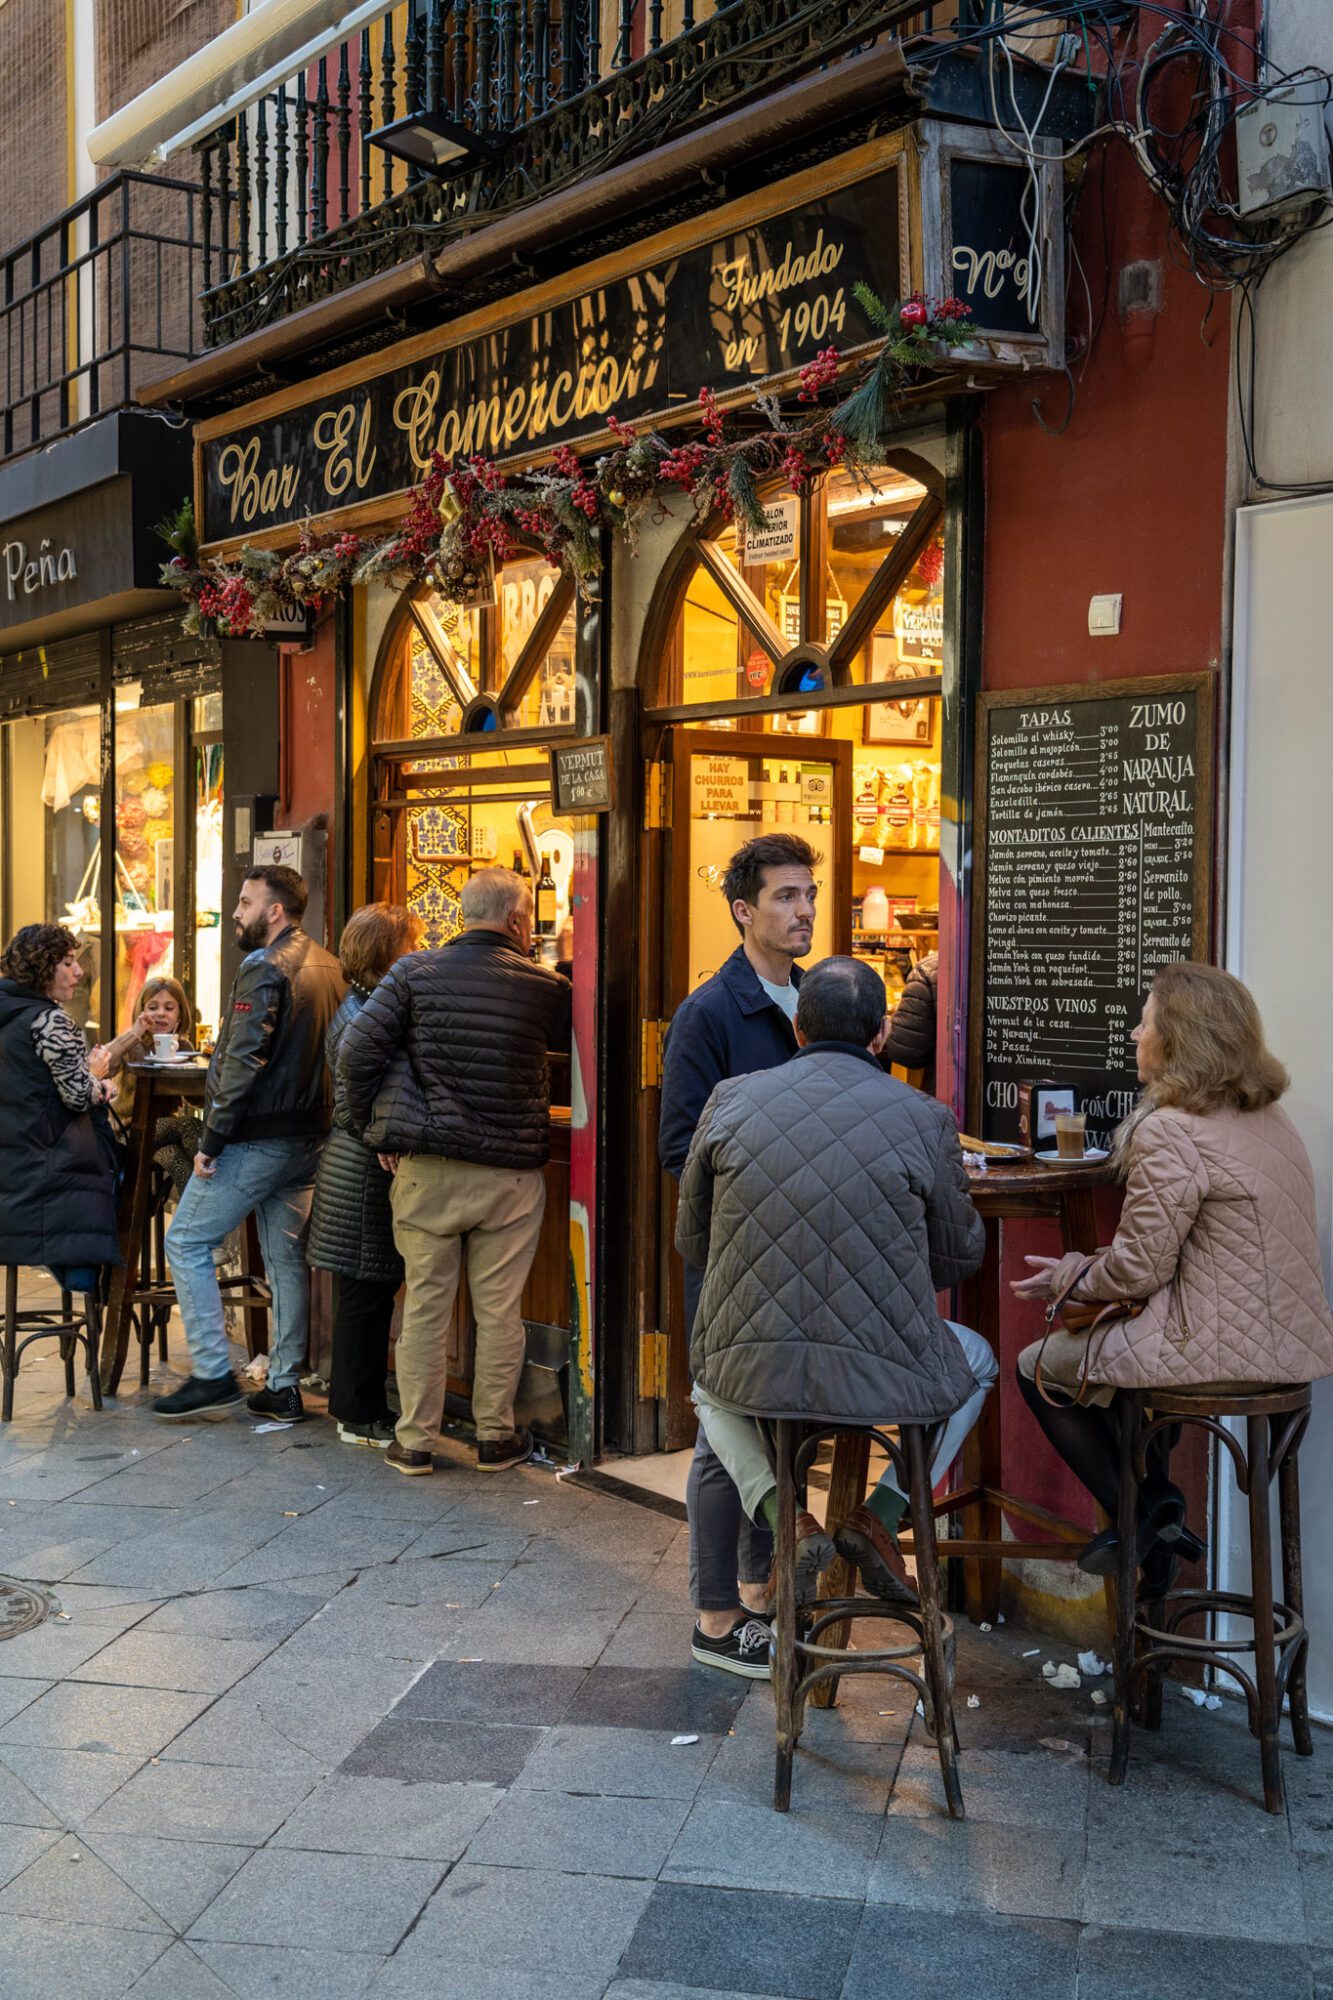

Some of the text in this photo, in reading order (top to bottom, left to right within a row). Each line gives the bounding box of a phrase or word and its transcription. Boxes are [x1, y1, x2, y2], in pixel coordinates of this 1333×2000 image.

[722, 228, 844, 311] Fundado
[725, 287, 846, 369] en 1904
[218, 356, 632, 524] Bar El Comercio
[763, 507, 784, 519] ALON
[747, 533, 794, 551] CLIMATIZADO
[2, 538, 77, 601] Peña
[1020, 709, 1071, 728] TAPAS
[1128, 701, 1186, 728] ZUMO
[990, 732, 1029, 746] Solomillo
[1031, 732, 1040, 742] al
[1144, 731, 1171, 751] DE
[990, 745, 1028, 758] Solomillo
[1030, 745, 1038, 755] al
[560, 750, 604, 771] VERMUT
[991, 759, 1029, 773] Croquetas
[709, 763, 730, 774] HAY
[1122, 754, 1195, 788] NARANJA
[561, 769, 605, 786] DE LA CASA
[694, 774, 744, 786] CHURROS
[706, 788, 733, 799] PARA
[700, 800, 739, 811] LLEVAR
[990, 809, 1020, 820] Tortilla
[1024, 809, 1033, 819] de
[988, 823, 1139, 844] MONTADITOS CALIENTES
[989, 848, 1014, 860] Jamón
[1049, 847, 1073, 858] aceite
[1072, 848, 1079, 860] y
[989, 861, 1014, 872] Jamón
[1054, 861, 1076, 872] queso
[988, 874, 1011, 885] Melva
[1028, 873, 1062, 886] pimiento
[1143, 869, 1189, 884] Serranito
[988, 887, 1011, 898] Melva
[1014, 888, 1027, 897] con
[1029, 888, 1050, 899] queso
[1143, 887, 1155, 900] de
[988, 899, 1011, 910] Melva
[1014, 901, 1027, 910] con
[988, 925, 1006, 934] Lomo
[1008, 925, 1016, 934] al
[1036, 927, 1048, 935] con
[1142, 933, 1191, 947] Serranito de
[987, 949, 1012, 961] Jamón
[1011, 950, 1029, 960] York
[1031, 952, 1043, 961] con
[1045, 953, 1065, 963] queso
[987, 962, 1012, 973] Jamón
[1012, 963, 1030, 973] York
[1033, 965, 1046, 974] con
[987, 975, 1013, 986] Jamón
[1014, 975, 1031, 986] York
[1034, 978, 1048, 986] con
[986, 996, 1128, 1015] NUESTROS VINOS COPA
[987, 1015, 1020, 1027] Vermut
[1023, 1016, 1033, 1027] de
[1036, 1016, 1045, 1027] la
[987, 1028, 998, 1038] De
[987, 1041, 998, 1051] De
[987, 1052, 1012, 1064] Pedro
